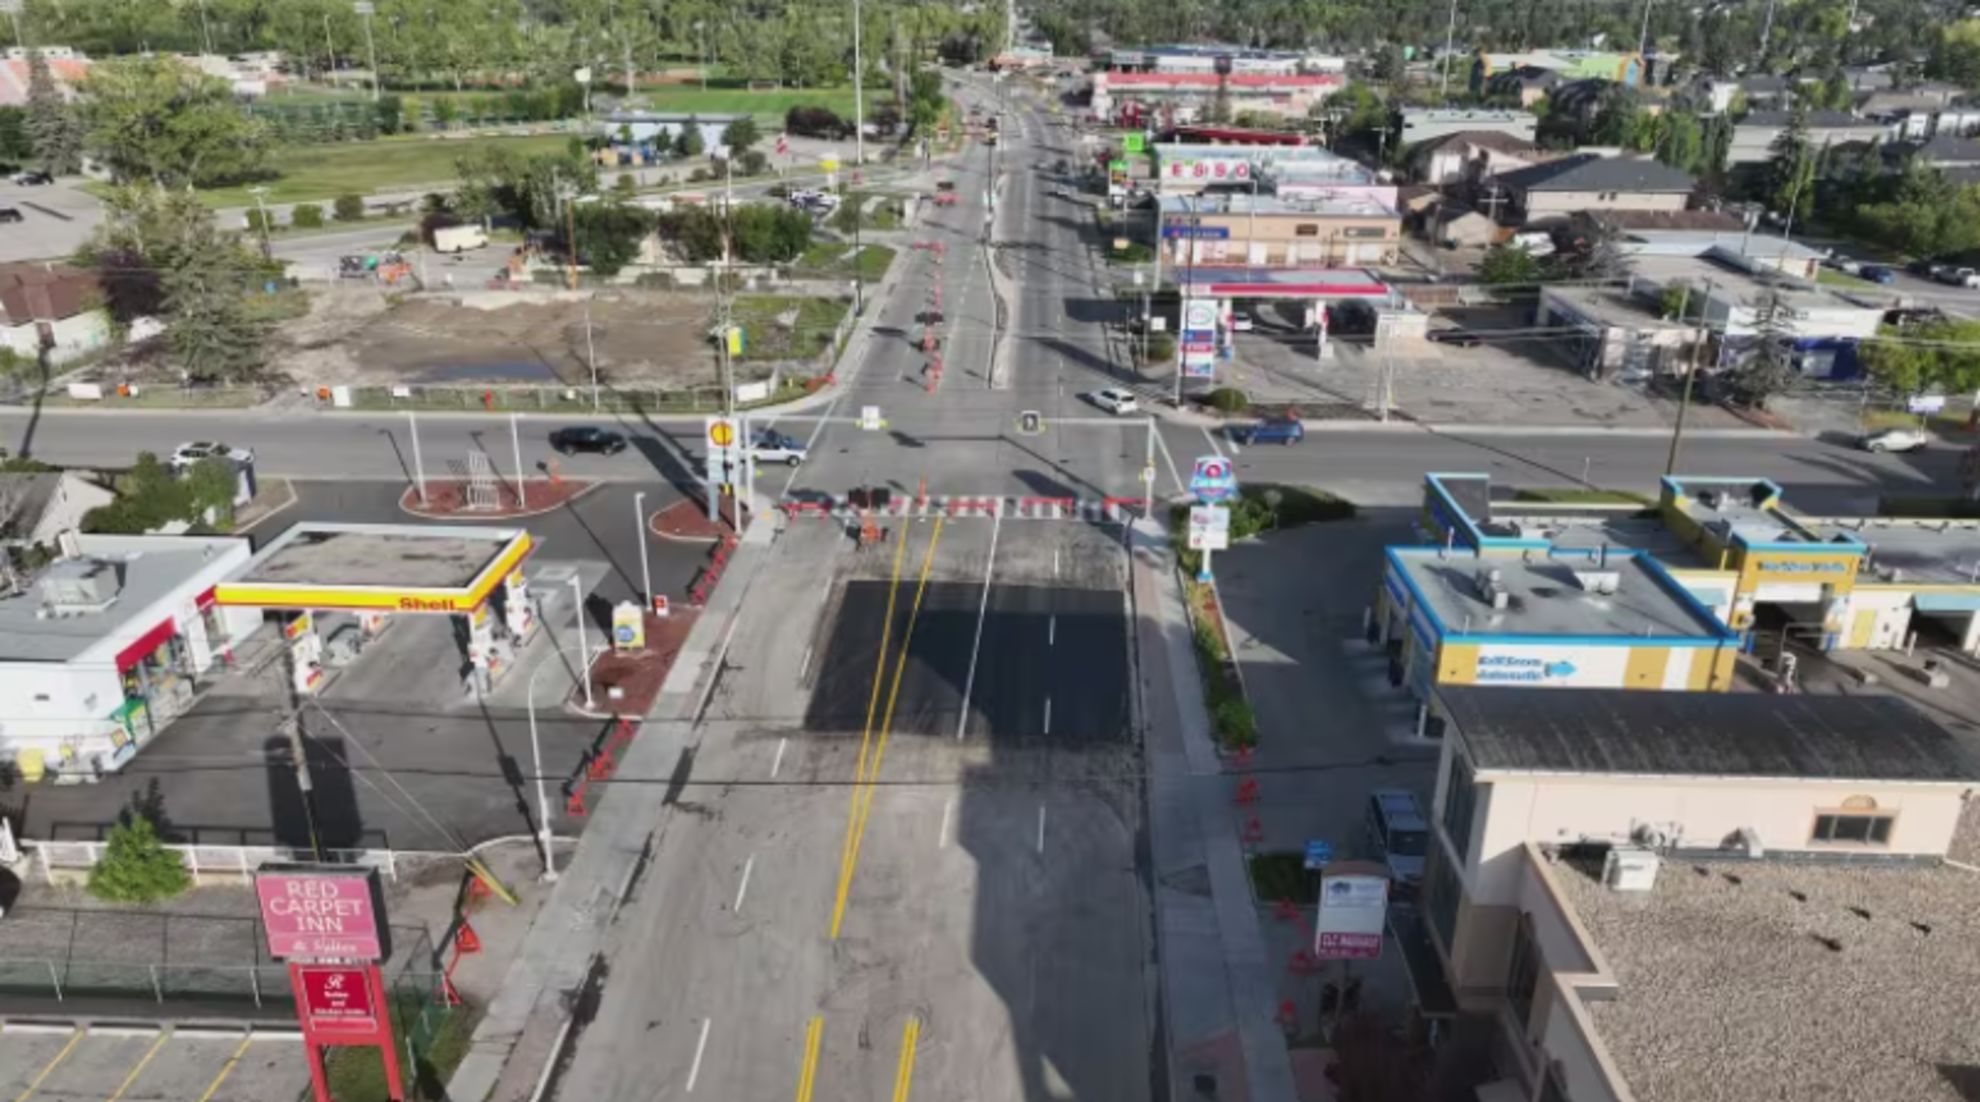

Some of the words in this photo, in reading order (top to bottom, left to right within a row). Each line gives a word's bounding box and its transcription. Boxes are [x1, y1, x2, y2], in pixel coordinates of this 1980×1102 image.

[400, 597, 455, 610] Shell
[286, 880, 339, 899] RED
[269, 897, 363, 916] CARPET
[296, 915, 344, 933] INN
